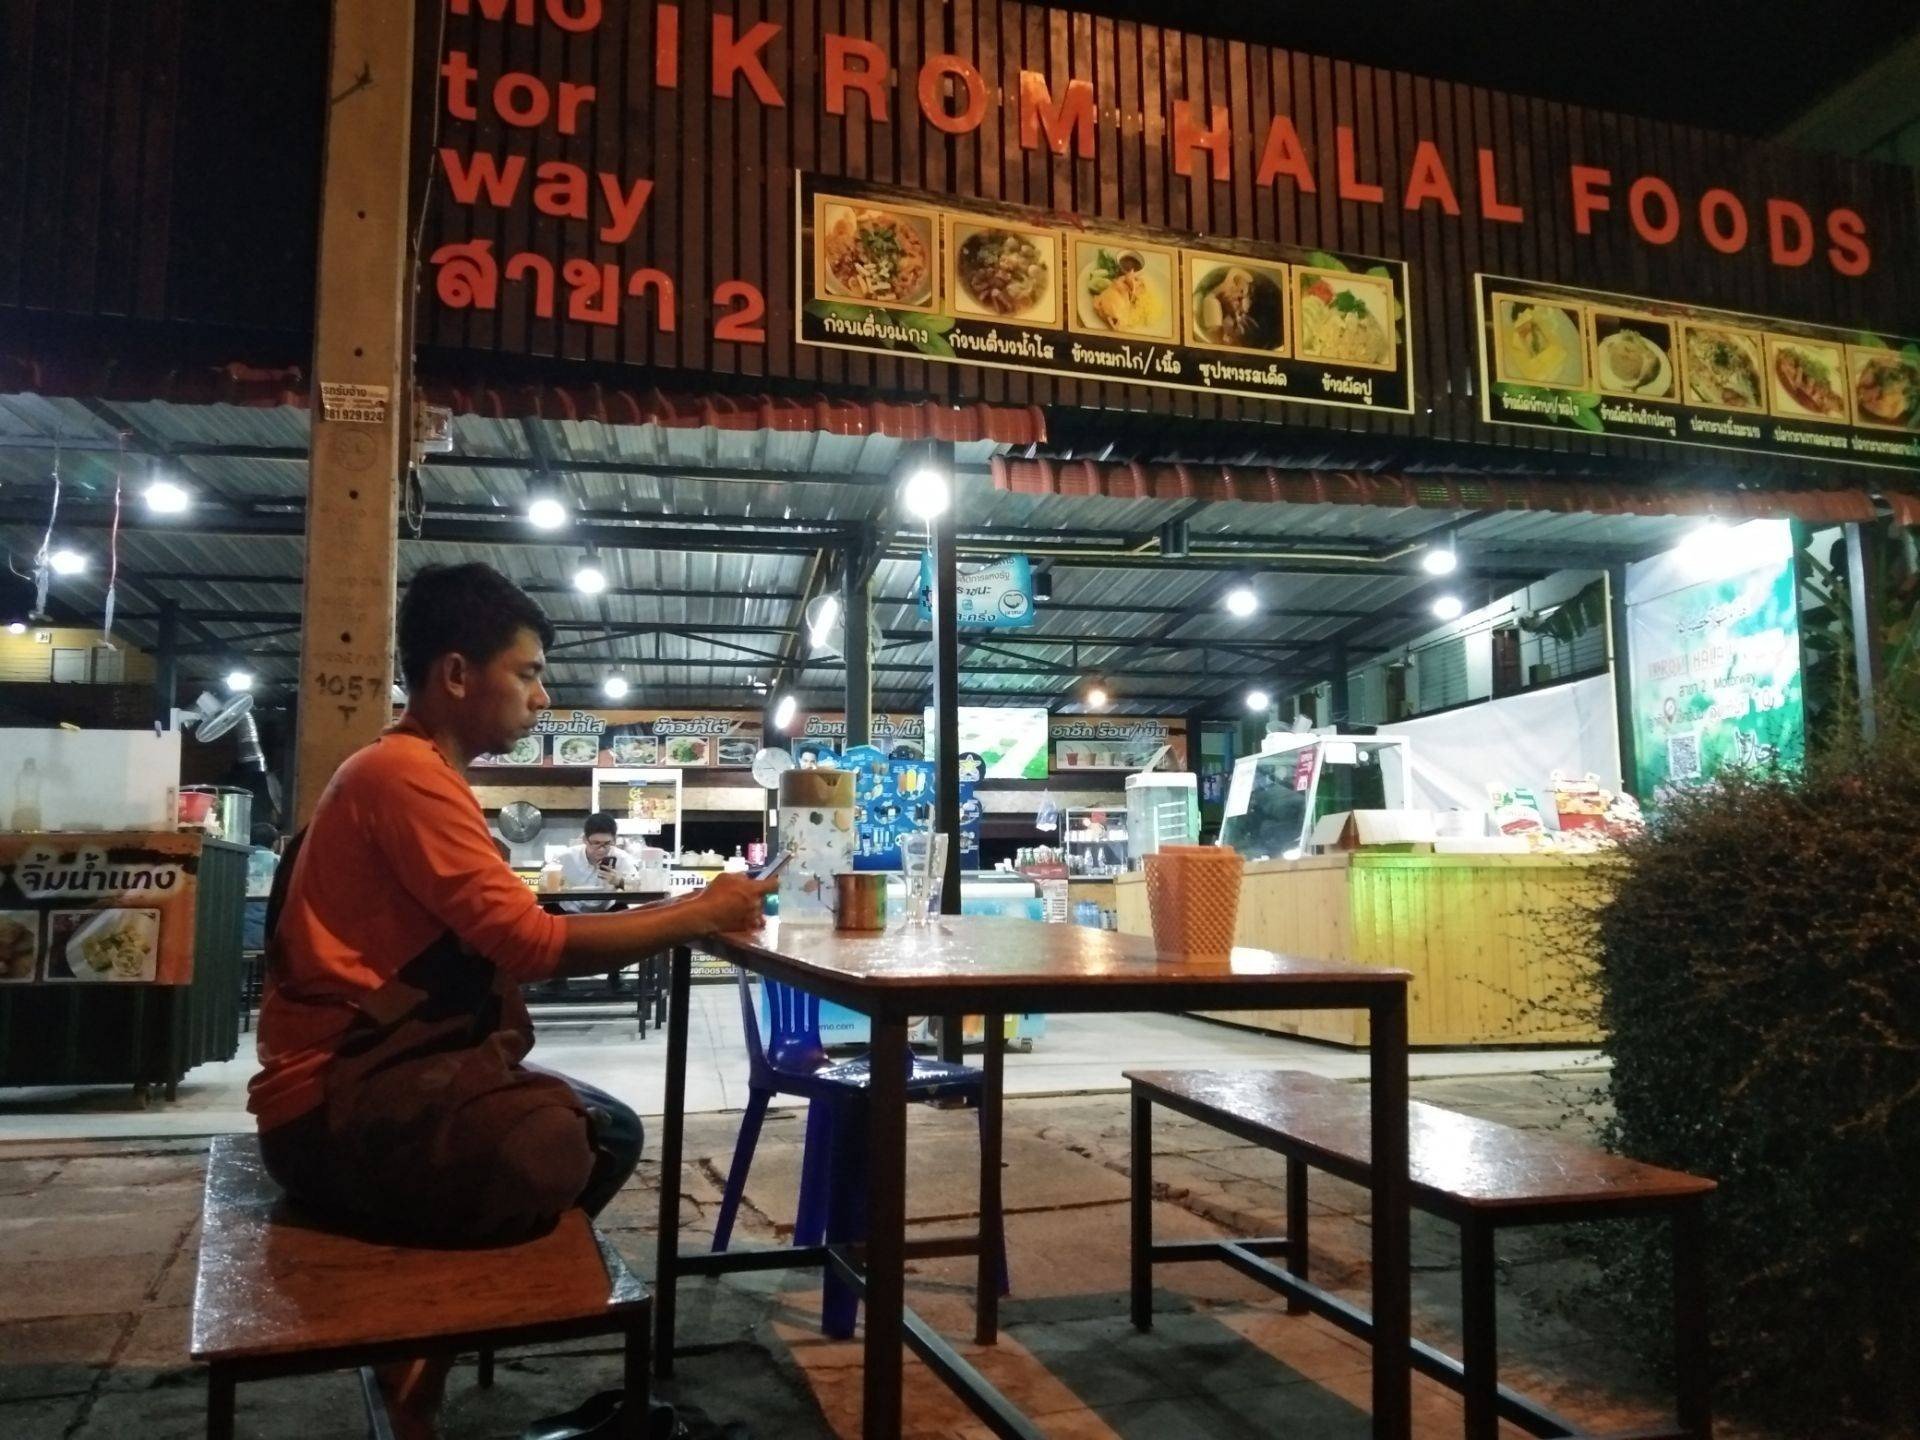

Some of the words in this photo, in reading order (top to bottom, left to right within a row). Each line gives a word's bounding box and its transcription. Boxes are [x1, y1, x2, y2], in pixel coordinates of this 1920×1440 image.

[450, 0, 602, 32] o
[441, 51, 596, 135] tor
[655, 3, 1096, 160] IKROM
[1172, 99, 1523, 224] HALAL
[1570, 164, 1872, 277] FOODS
[439, 147, 654, 244] way
[430, 239, 675, 332] สาขา
[713, 280, 766, 343] 2
[1321, 373, 1373, 404] ข้าวผัดปู
[22, 853, 176, 891] จิ้มน้ำแกง
